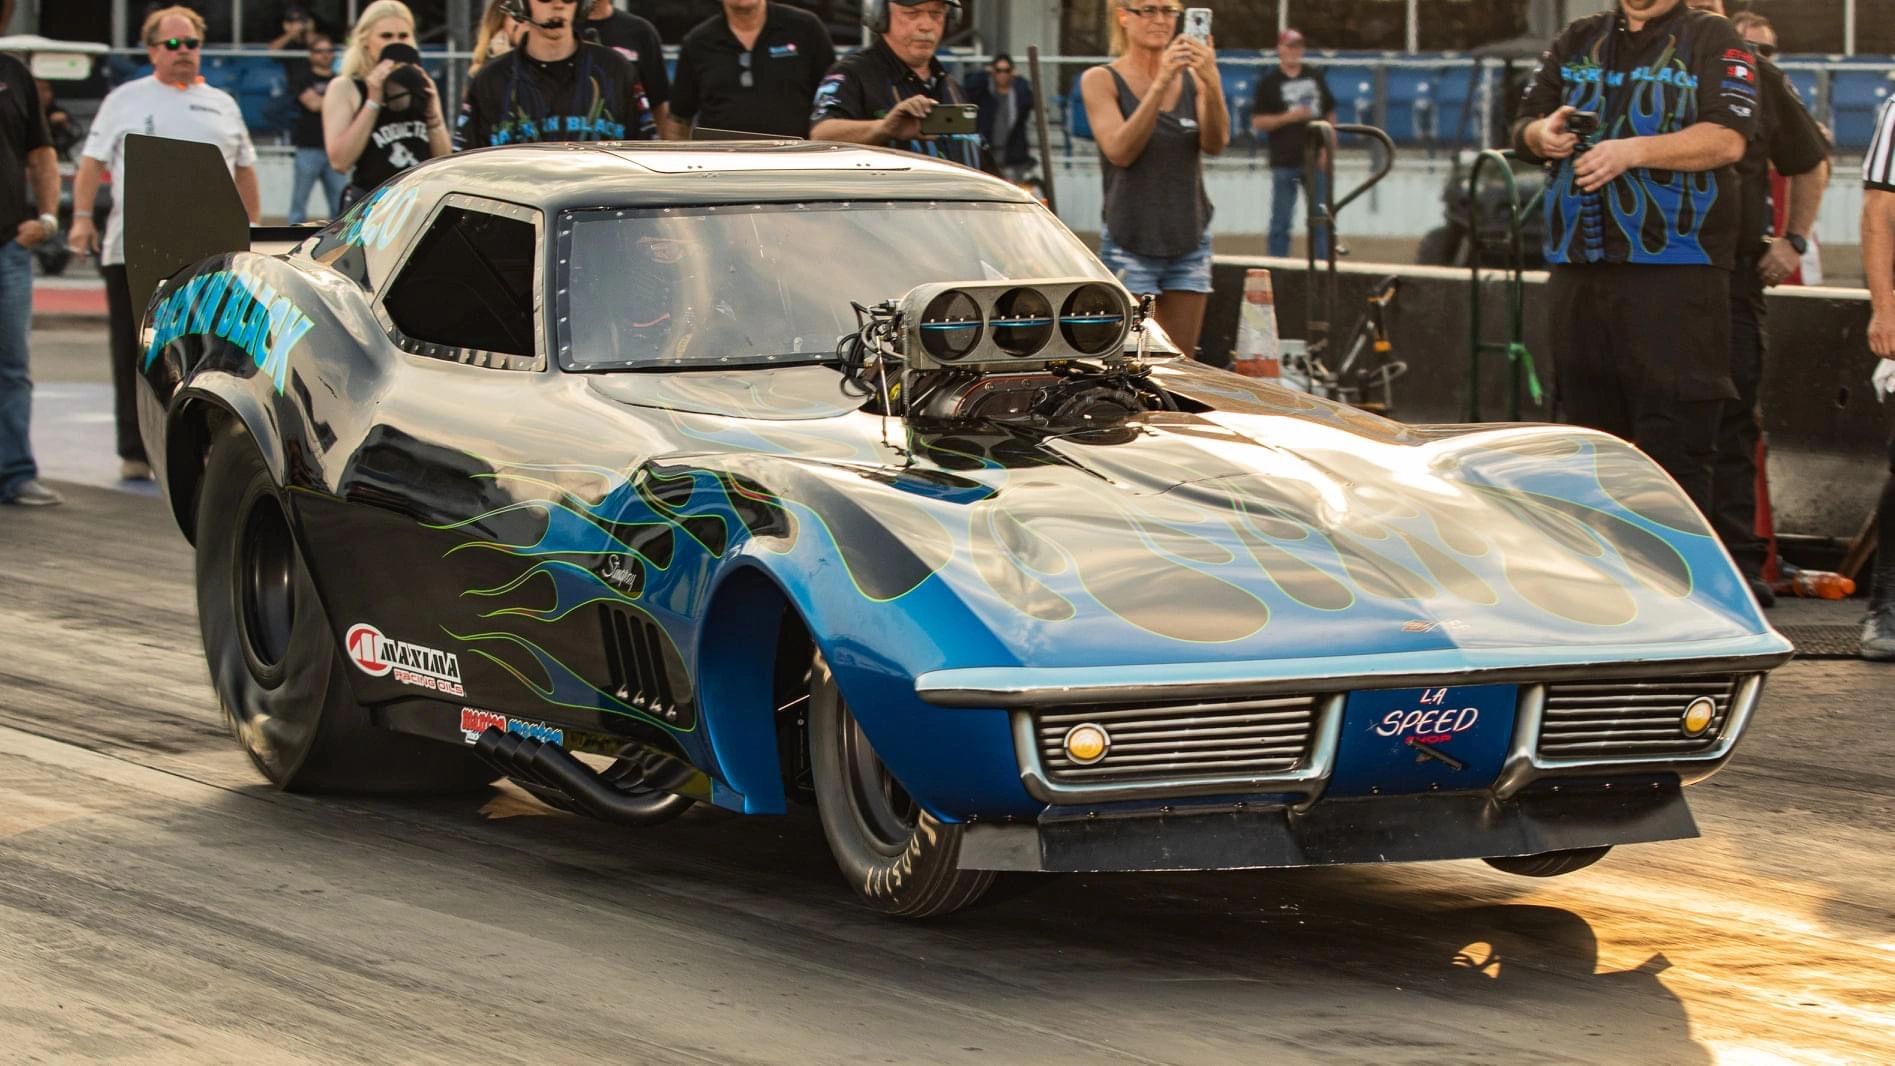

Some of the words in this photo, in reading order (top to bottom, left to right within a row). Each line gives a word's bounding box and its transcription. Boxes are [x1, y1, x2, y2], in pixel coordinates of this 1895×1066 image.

[372, 121, 429, 148] ADDICTE
[214, 271, 315, 397] BLACK
[380, 641, 461, 680] MAXIMA
[394, 669, 436, 689] RACING
[437, 680, 464, 696] OILS
[1376, 707, 1479, 736] SPEED
